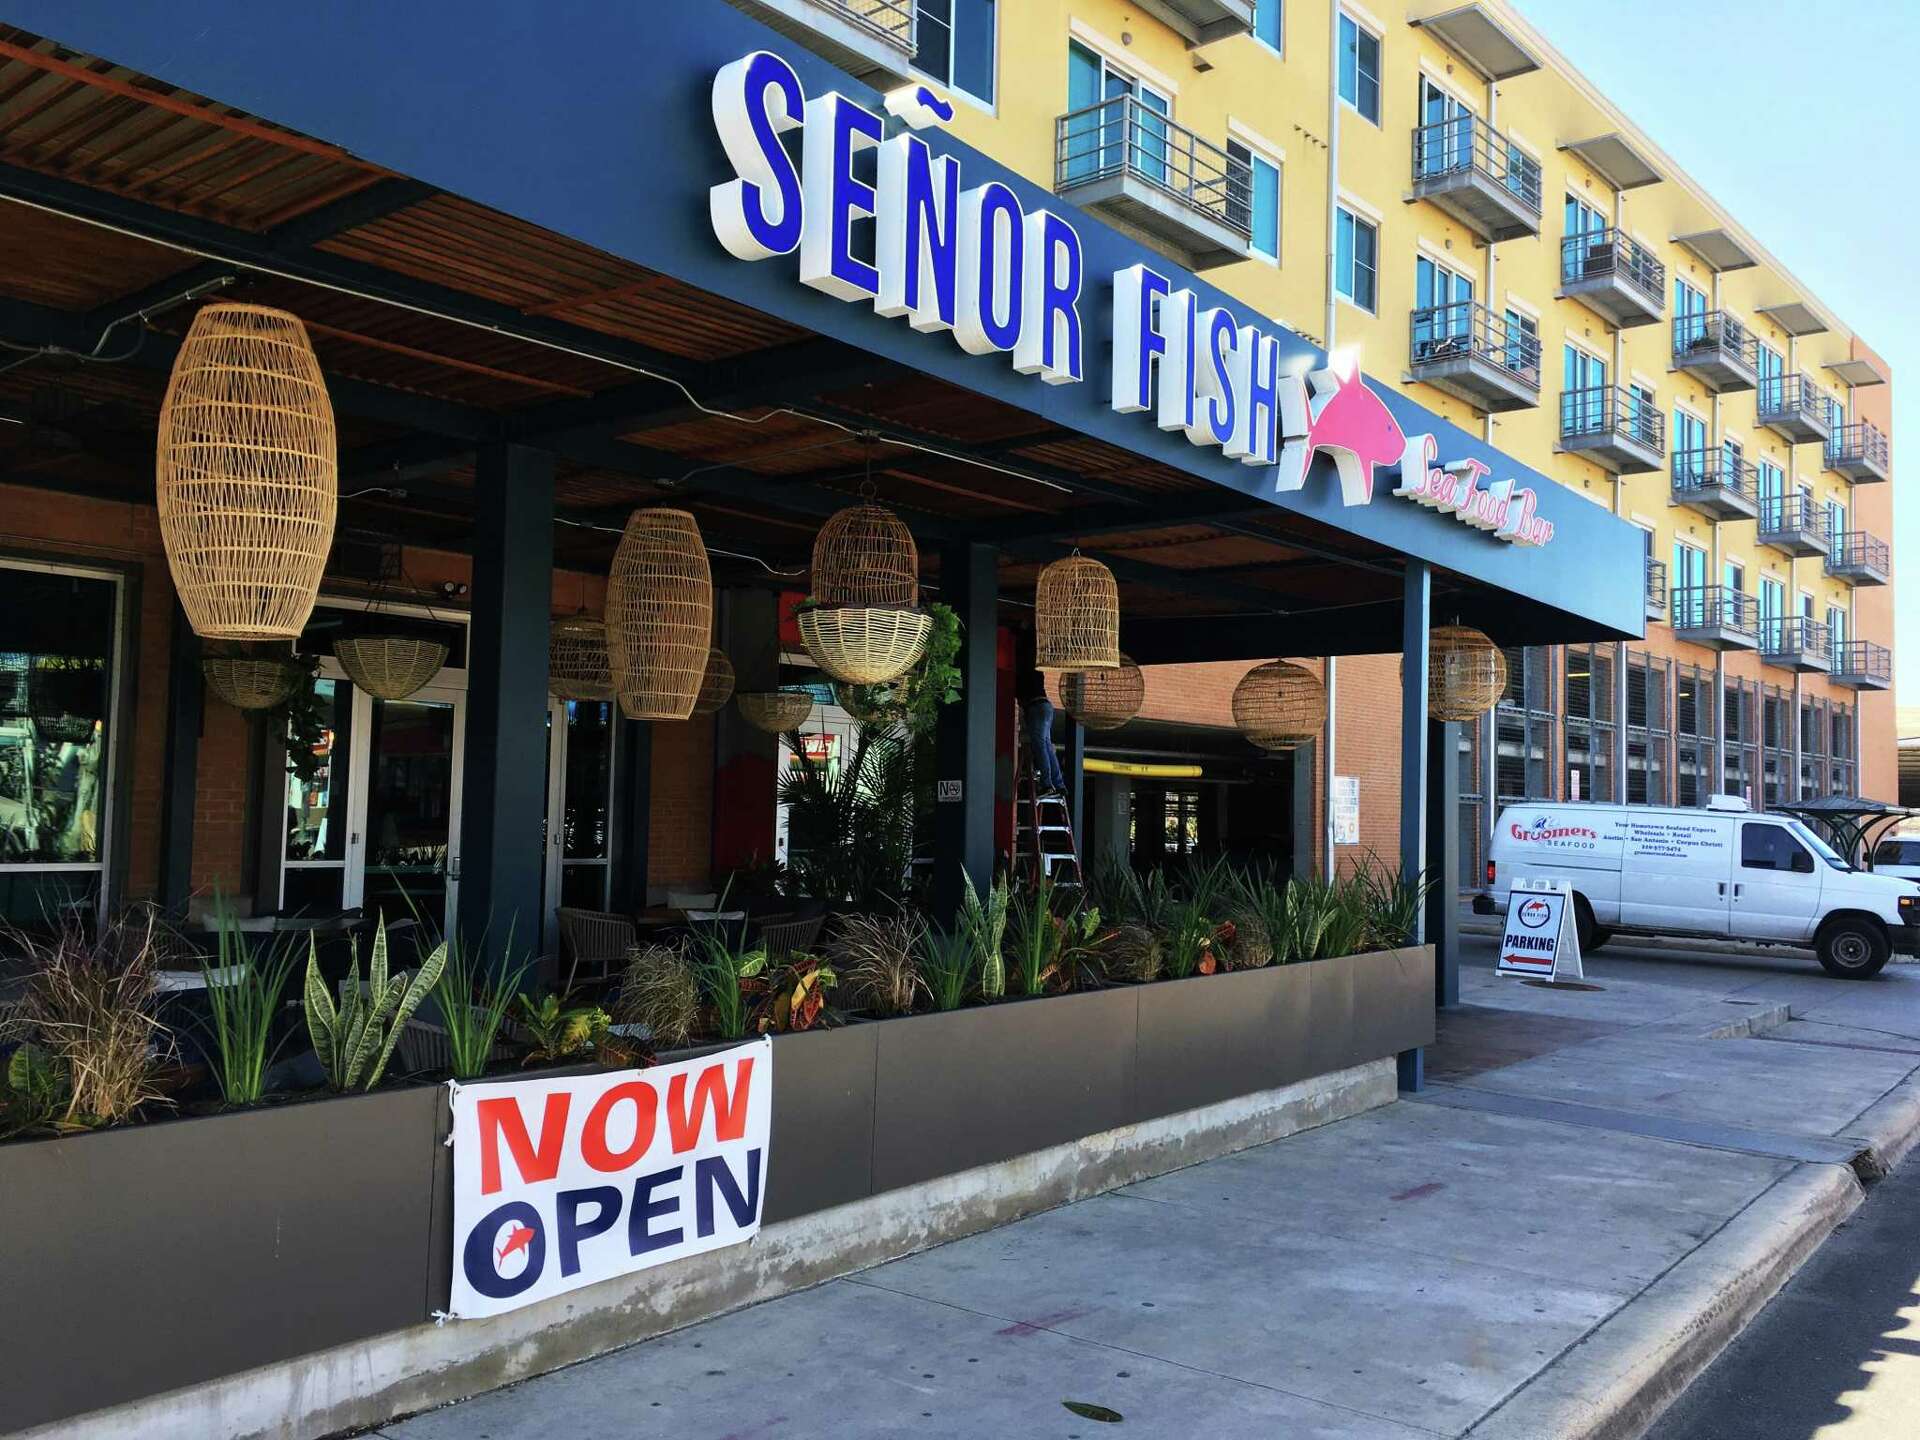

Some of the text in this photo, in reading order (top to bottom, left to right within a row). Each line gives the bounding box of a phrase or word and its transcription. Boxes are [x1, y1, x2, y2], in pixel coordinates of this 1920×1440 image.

[710, 50, 1279, 466] SEÑOR FISH
[1401, 433, 1458, 507] Sea
[1507, 488, 1554, 546] Bar
[1546, 839, 1595, 850] SEAFOOD
[1505, 934, 1555, 952] PARKING
[476, 1057, 755, 1196] NOW
[463, 1147, 762, 1299] OPEN
